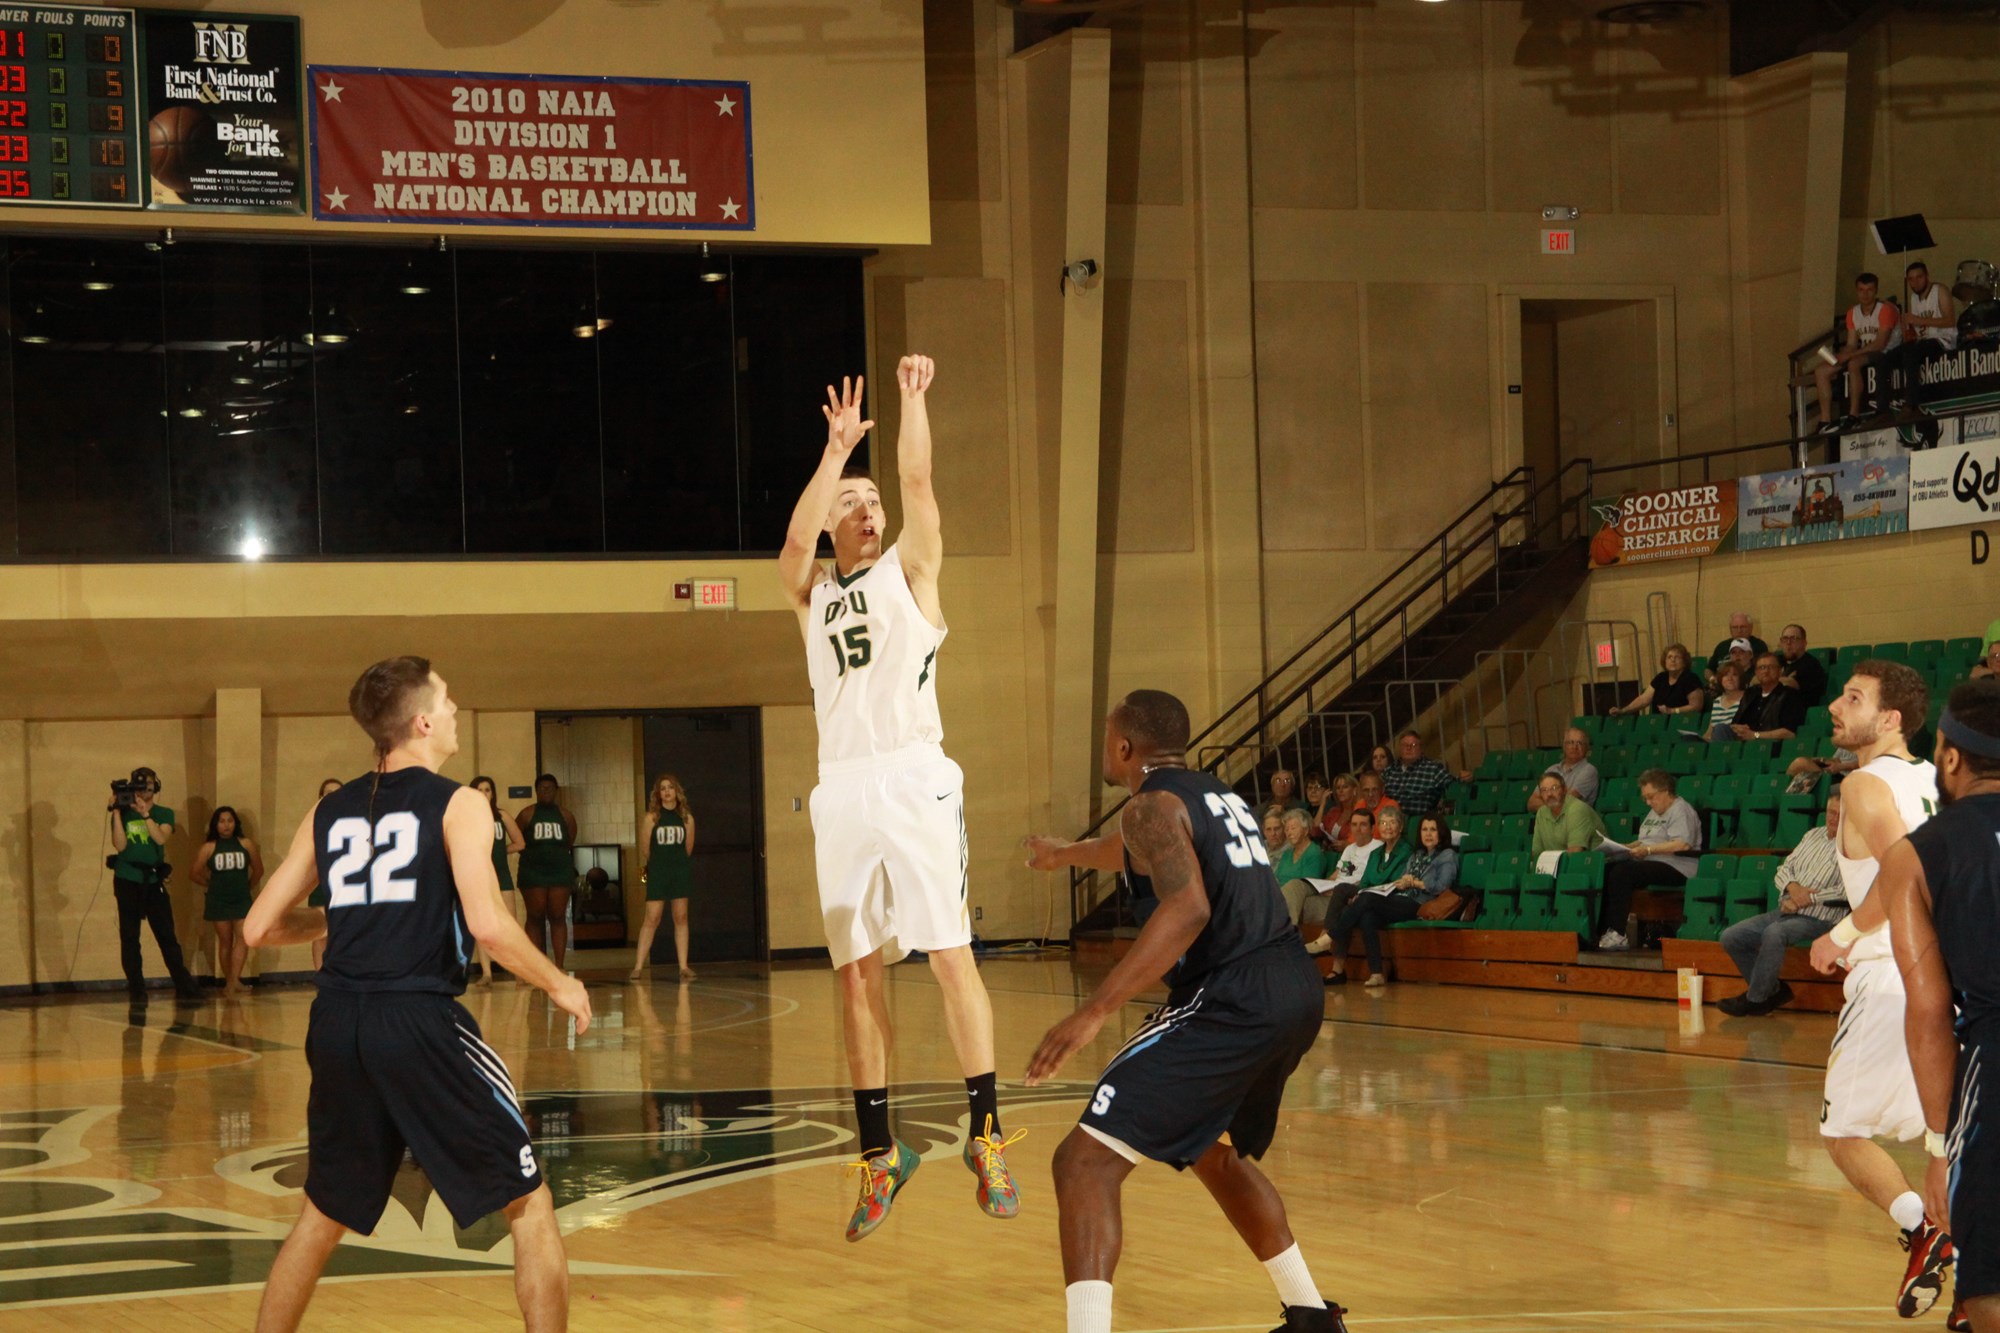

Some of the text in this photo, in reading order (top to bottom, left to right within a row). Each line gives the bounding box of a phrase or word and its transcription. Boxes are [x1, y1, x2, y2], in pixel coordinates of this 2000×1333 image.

[35, 11, 74, 25] FOULS
[83, 14, 126, 28] POINTS
[196, 29, 247, 59] FNB
[106, 70, 122, 96] 5
[164, 64, 275, 88] First National
[165, 83, 201, 100] Bank
[217, 85, 253, 102] Trust
[256, 87, 277, 103] Co.
[452, 87, 616, 117] 2010 NAIA
[107, 105, 124, 131] 9
[234, 113, 263, 128] Your
[217, 122, 280, 143] Bank
[454, 120, 617, 150] DIVISION 1
[101, 139, 125, 166] 10
[225, 140, 285, 157] for Life.
[190, 176, 217, 184] SHAWNEE
[381, 150, 687, 184] MEN'S BASKETBALL
[110, 174, 126, 199] 4
[194, 196, 293, 206] www.fnbokla.com
[373, 183, 697, 217] NATIONAL CHAMPION
[1549, 232, 1570, 251] EXIT
[1904, 350, 1967, 388] sketball
[1912, 476, 1948, 489] Proud supporter
[1929, 489, 1948, 499] Athletics
[1623, 485, 1720, 516] SOONER
[1623, 506, 1721, 533] CLINICAL
[1844, 511, 1907, 539] KUBOTA
[1623, 525, 1720, 551] RESEARCH
[1971, 530, 1990, 565] D
[1627, 545, 1710, 562] soonerclinical.com
[702, 584, 728, 605] EXIT
[824, 590, 868, 627] OU
[828, 624, 871, 677] 15
[534, 822, 563, 840] OBU
[656, 826, 684, 845] OBU
[1203, 792, 1270, 868] 35
[214, 852, 245, 871] OBU
[327, 811, 420, 909] 22
[1091, 1083, 1116, 1116] S
[519, 1144, 537, 1178] S
